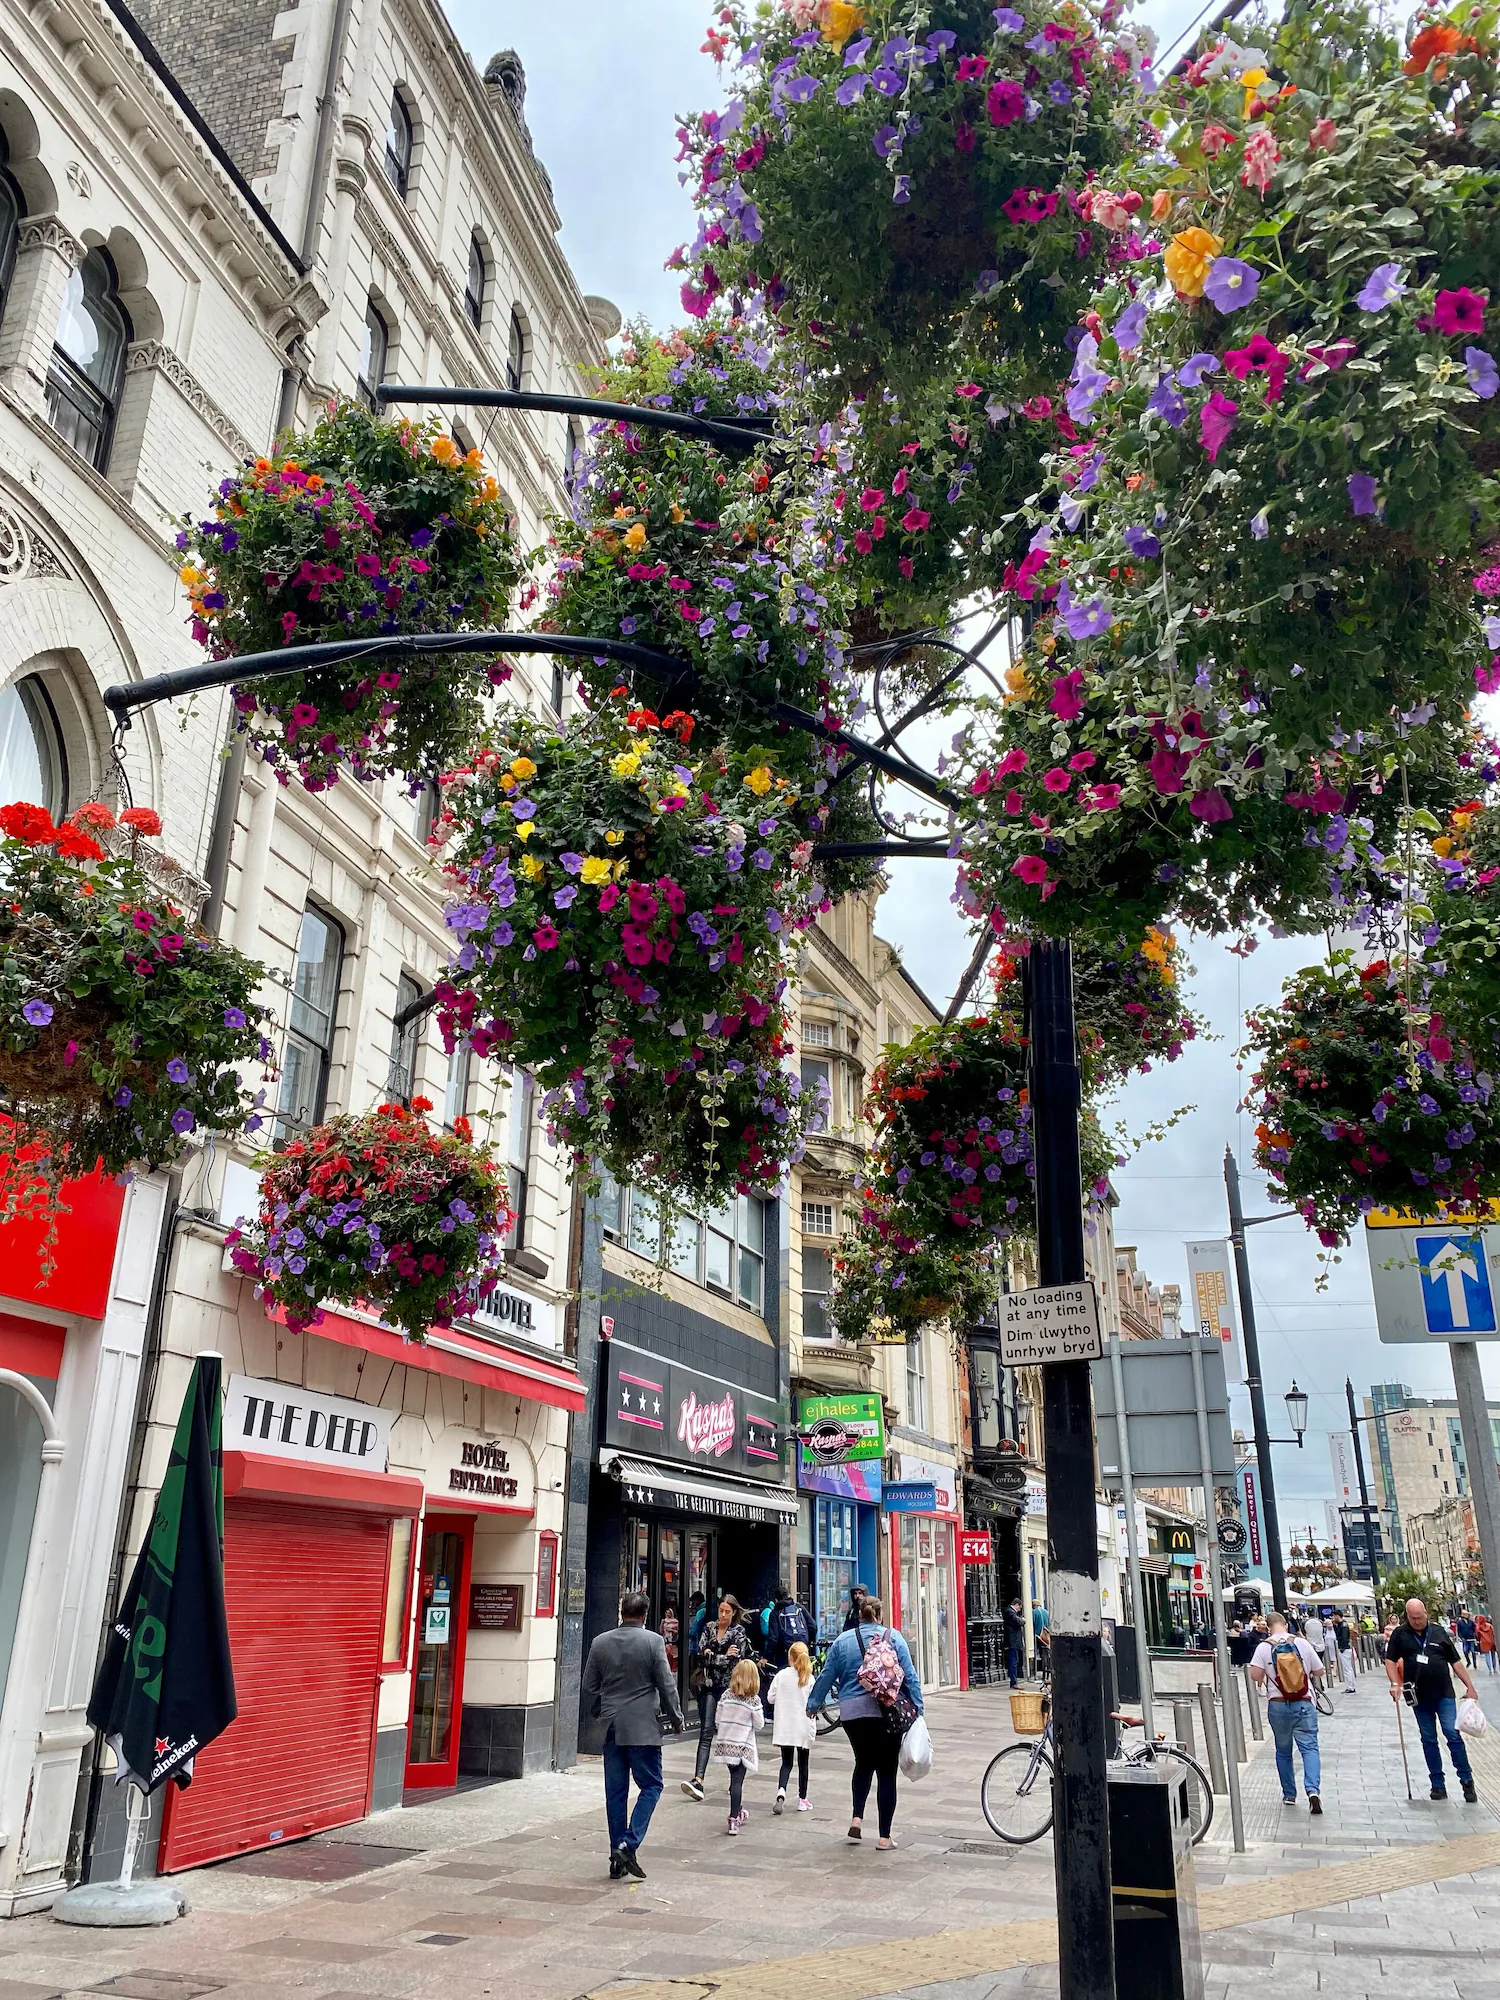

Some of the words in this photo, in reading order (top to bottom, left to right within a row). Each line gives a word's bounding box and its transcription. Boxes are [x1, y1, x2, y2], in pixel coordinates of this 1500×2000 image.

[1362, 929, 1425, 950] ZON
[1196, 1274, 1204, 1290] THE
[1216, 1272, 1226, 1305] WELSH
[486, 1290, 536, 1330] HOTEL
[1008, 1296, 1027, 1308] No
[1033, 1290, 1083, 1305] loading
[1199, 1293, 1208, 1318] YEAR
[1207, 1273, 1218, 1326] UNIVERSITY
[1007, 1310, 1021, 1322] at
[1026, 1309, 1050, 1320] any
[1056, 1305, 1087, 1316] time
[1007, 1330, 1033, 1342] Dim
[1201, 1321, 1211, 1337] 202
[1212, 1328, 1220, 1336] O
[1006, 1345, 1056, 1359] unrhyw
[1063, 1339, 1095, 1354] bryd
[242, 1395, 303, 1445] THE
[305, 1410, 378, 1457] DEEP
[677, 1391, 735, 1452] Kaspa's
[461, 1442, 510, 1472] HOTEL
[449, 1468, 518, 1497] ENTRANCE
[675, 1493, 689, 1510] THE
[691, 1496, 714, 1513] GELATO
[722, 1501, 746, 1518] DESSERT
[886, 1491, 932, 1500] EDWARDS
[1246, 1477, 1255, 1517] Brewery
[962, 1543, 989, 1557] £14
[1250, 1520, 1260, 1560] Quarter
[150, 1739, 199, 1784] eineken
